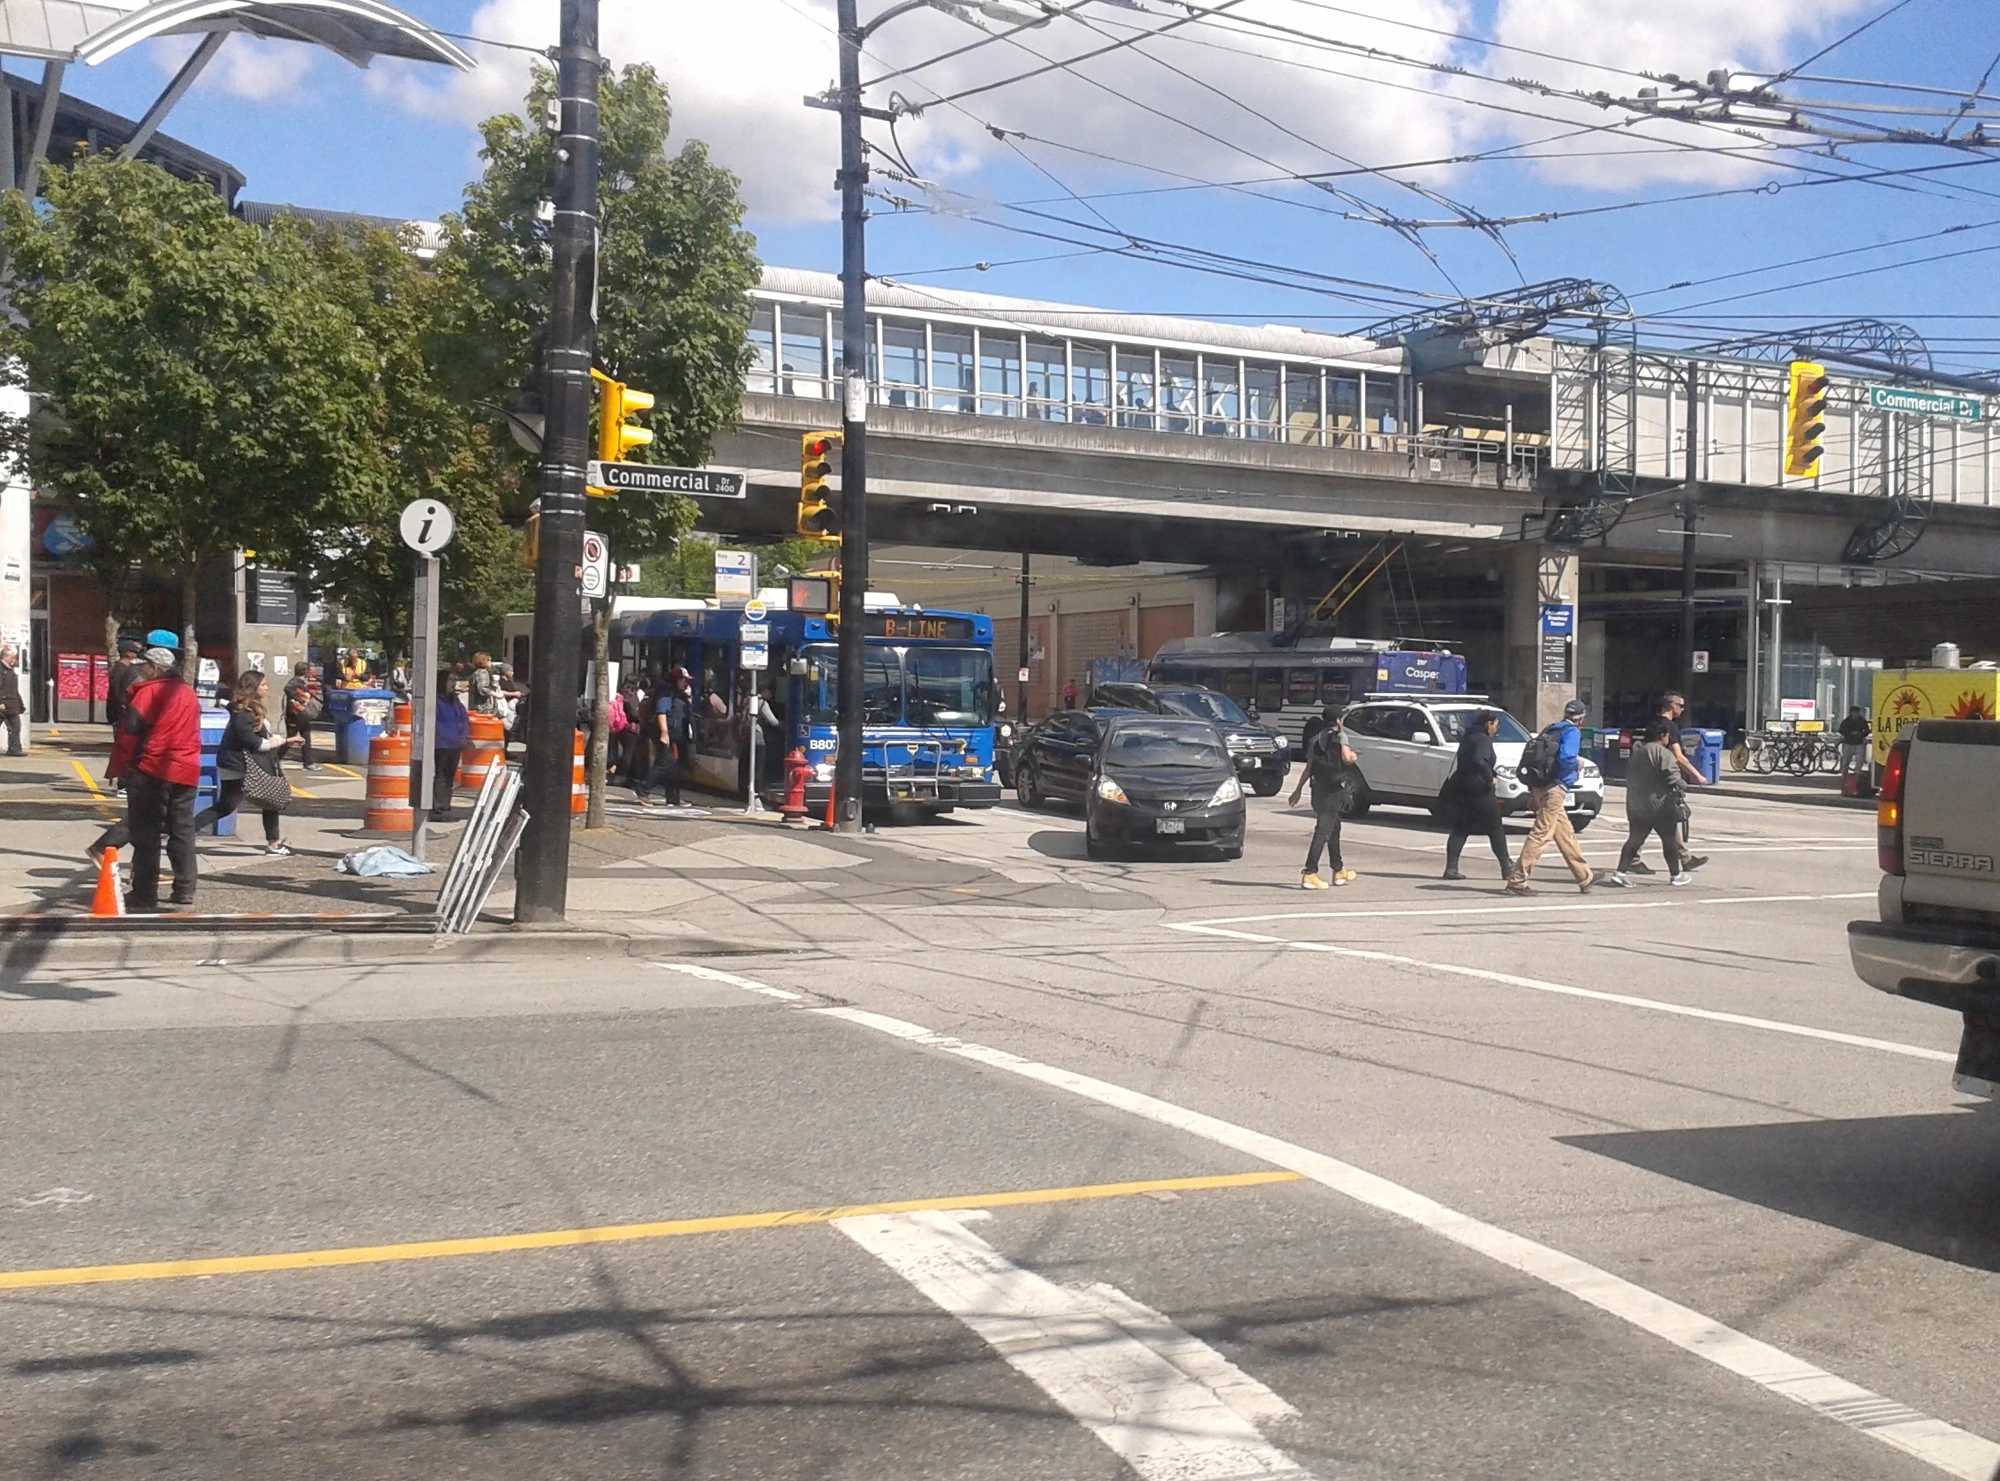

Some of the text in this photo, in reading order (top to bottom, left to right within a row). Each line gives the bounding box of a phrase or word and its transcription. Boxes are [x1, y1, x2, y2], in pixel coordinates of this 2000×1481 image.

[1875, 390, 1973, 417] Commercial Dr
[608, 468, 730, 491] Commercial Dr
[715, 484, 735, 493] 2400
[737, 554, 746, 566] 2
[885, 618, 947, 638] B-LINE
[1405, 666, 1440, 681] Casper
[1877, 716, 1892, 733] LA
[809, 739, 837, 750] B80
[1909, 848, 1993, 872] SIERRA
